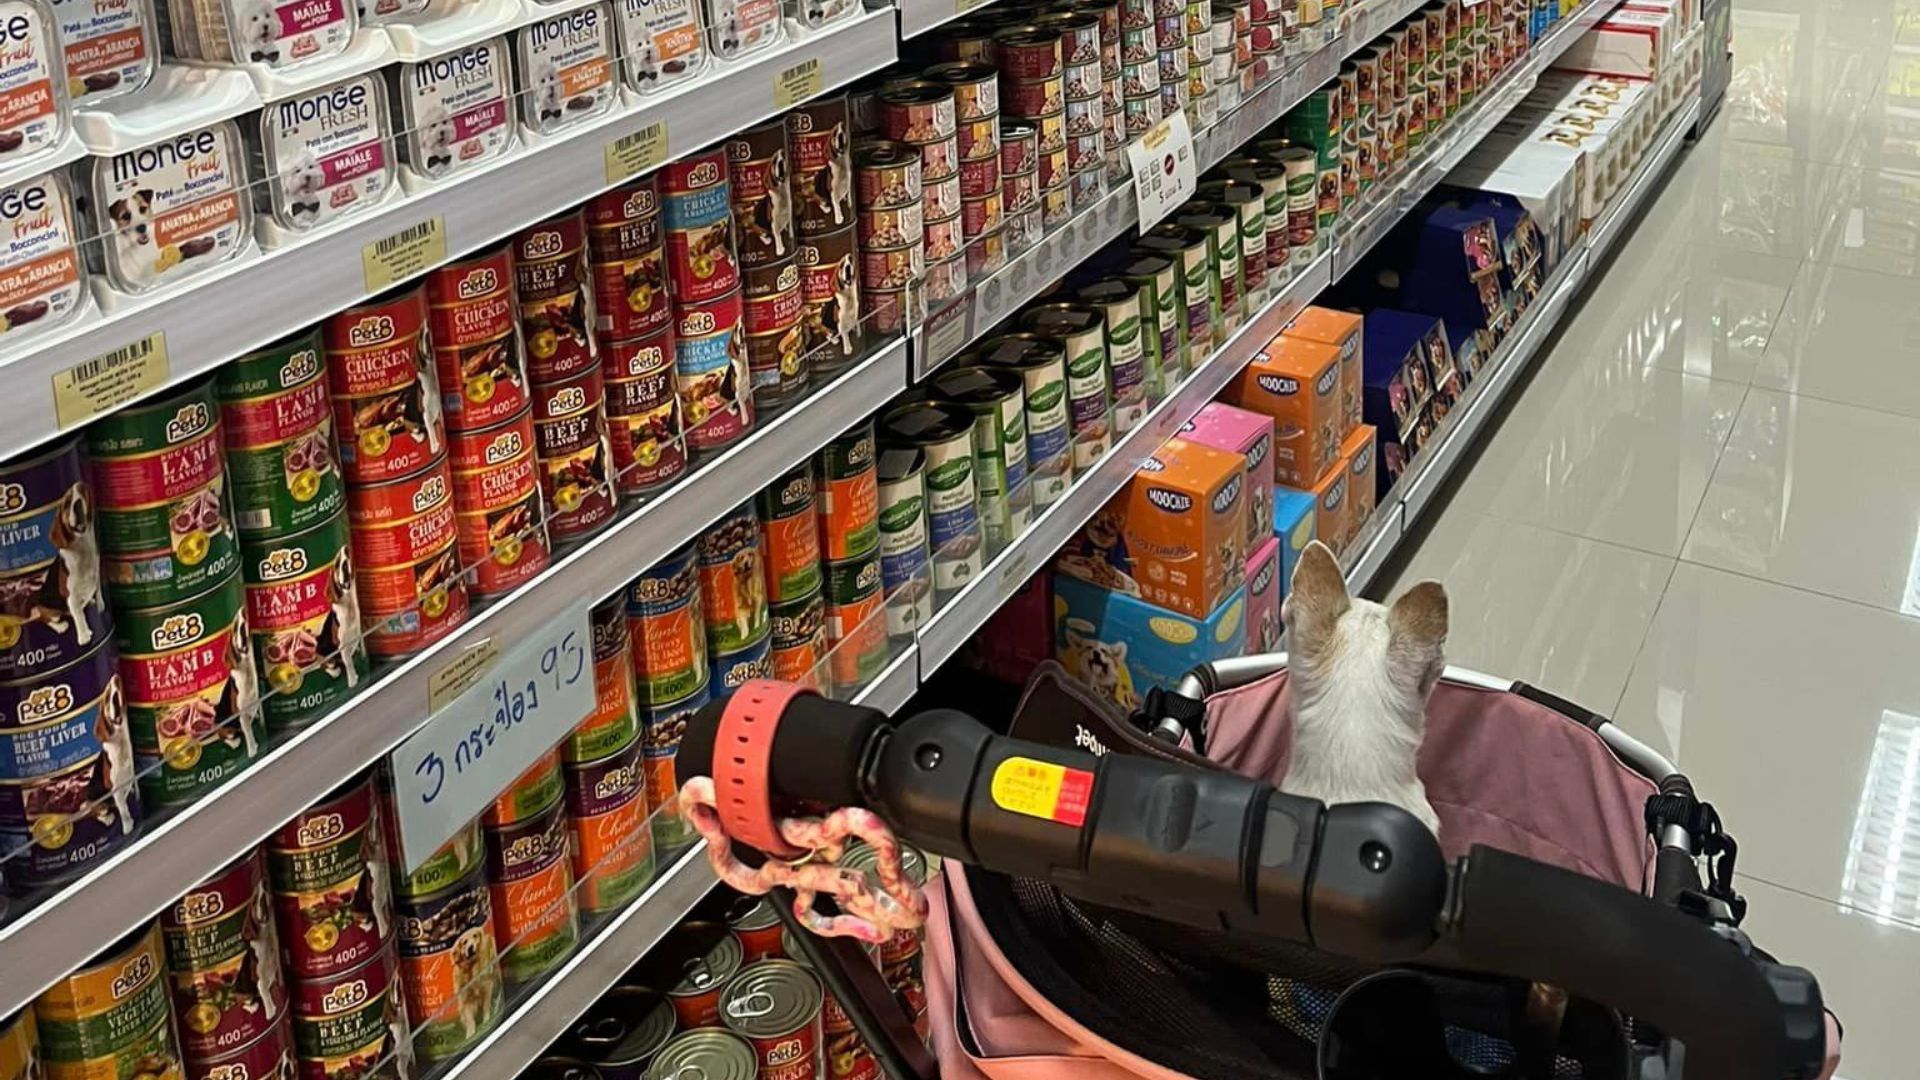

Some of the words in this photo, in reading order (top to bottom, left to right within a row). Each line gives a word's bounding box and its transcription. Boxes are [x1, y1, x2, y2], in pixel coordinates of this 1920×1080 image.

[292, 4, 333, 22] MAIALE
[454, 64, 493, 89] FRESH
[320, 103, 369, 131] FRESH
[464, 106, 496, 127] MAIALE
[334, 149, 372, 172] MAIALE
[161, 211, 196, 235] ANATRA
[200, 198, 234, 218] ARANCIA
[619, 219, 658, 244] BEEF
[29, 259, 73, 284] ARANCIA
[518, 263, 568, 285] BEEF
[459, 270, 497, 297] Pet8
[454, 299, 511, 326] CHICKEN
[351, 317, 393, 345] Pet8
[455, 319, 493, 334] FLAVOR
[281, 351, 316, 386] Pet8
[345, 347, 411, 375] CHICKEN
[554, 357, 574, 371] 400
[630, 347, 662, 374] Pet8
[347, 369, 388, 384] FLAVOR
[624, 376, 666, 398] BEEF
[1258, 375, 1299, 393] MOOCHIE
[491, 400, 511, 416] 400
[549, 388, 584, 414] Pet8
[168, 403, 208, 442] Pet8
[278, 406, 316, 428] FLAVOR
[544, 417, 590, 441] BEEF
[707, 425, 725, 438] 400
[488, 434, 521, 462] Pet8
[545, 434, 579, 448] FLAVOR
[160, 439, 218, 477] LAMB
[387, 454, 410, 470] 400
[162, 462, 206, 487] FLAVOR
[481, 460, 534, 491] CHICKEN
[658, 464, 674, 478] 400
[483, 483, 518, 498] FLAVOR
[1149, 489, 1191, 510] MOOCHIE
[318, 495, 335, 514] 400
[579, 509, 597, 525] 400
[2, 524, 41, 547] LIVER
[206, 556, 227, 578] 400
[260, 550, 306, 579] Pet8
[519, 560, 536, 576] 400
[255, 582, 318, 609] LAMB
[256, 602, 299, 618] FLAVOR
[154, 615, 202, 649] Pet8
[17, 649, 46, 667] 400
[149, 649, 216, 681] LAMB
[150, 673, 196, 691] FLAVOR
[19, 687, 72, 720] Pet8
[299, 691, 323, 709] 400
[415, 751, 445, 804] 3
[541, 631, 584, 691] 95
[13, 734, 48, 755] BEEF
[50, 721, 88, 748] LIVER
[197, 765, 223, 784] 400
[300, 816, 342, 844] Pet8
[70, 842, 97, 861] 400
[293, 851, 341, 873] BEEF
[334, 948, 358, 965] 400
[325, 983, 366, 1011] Pet8
[319, 1017, 364, 1037] BEEF
[217, 1030, 242, 1047] 400
